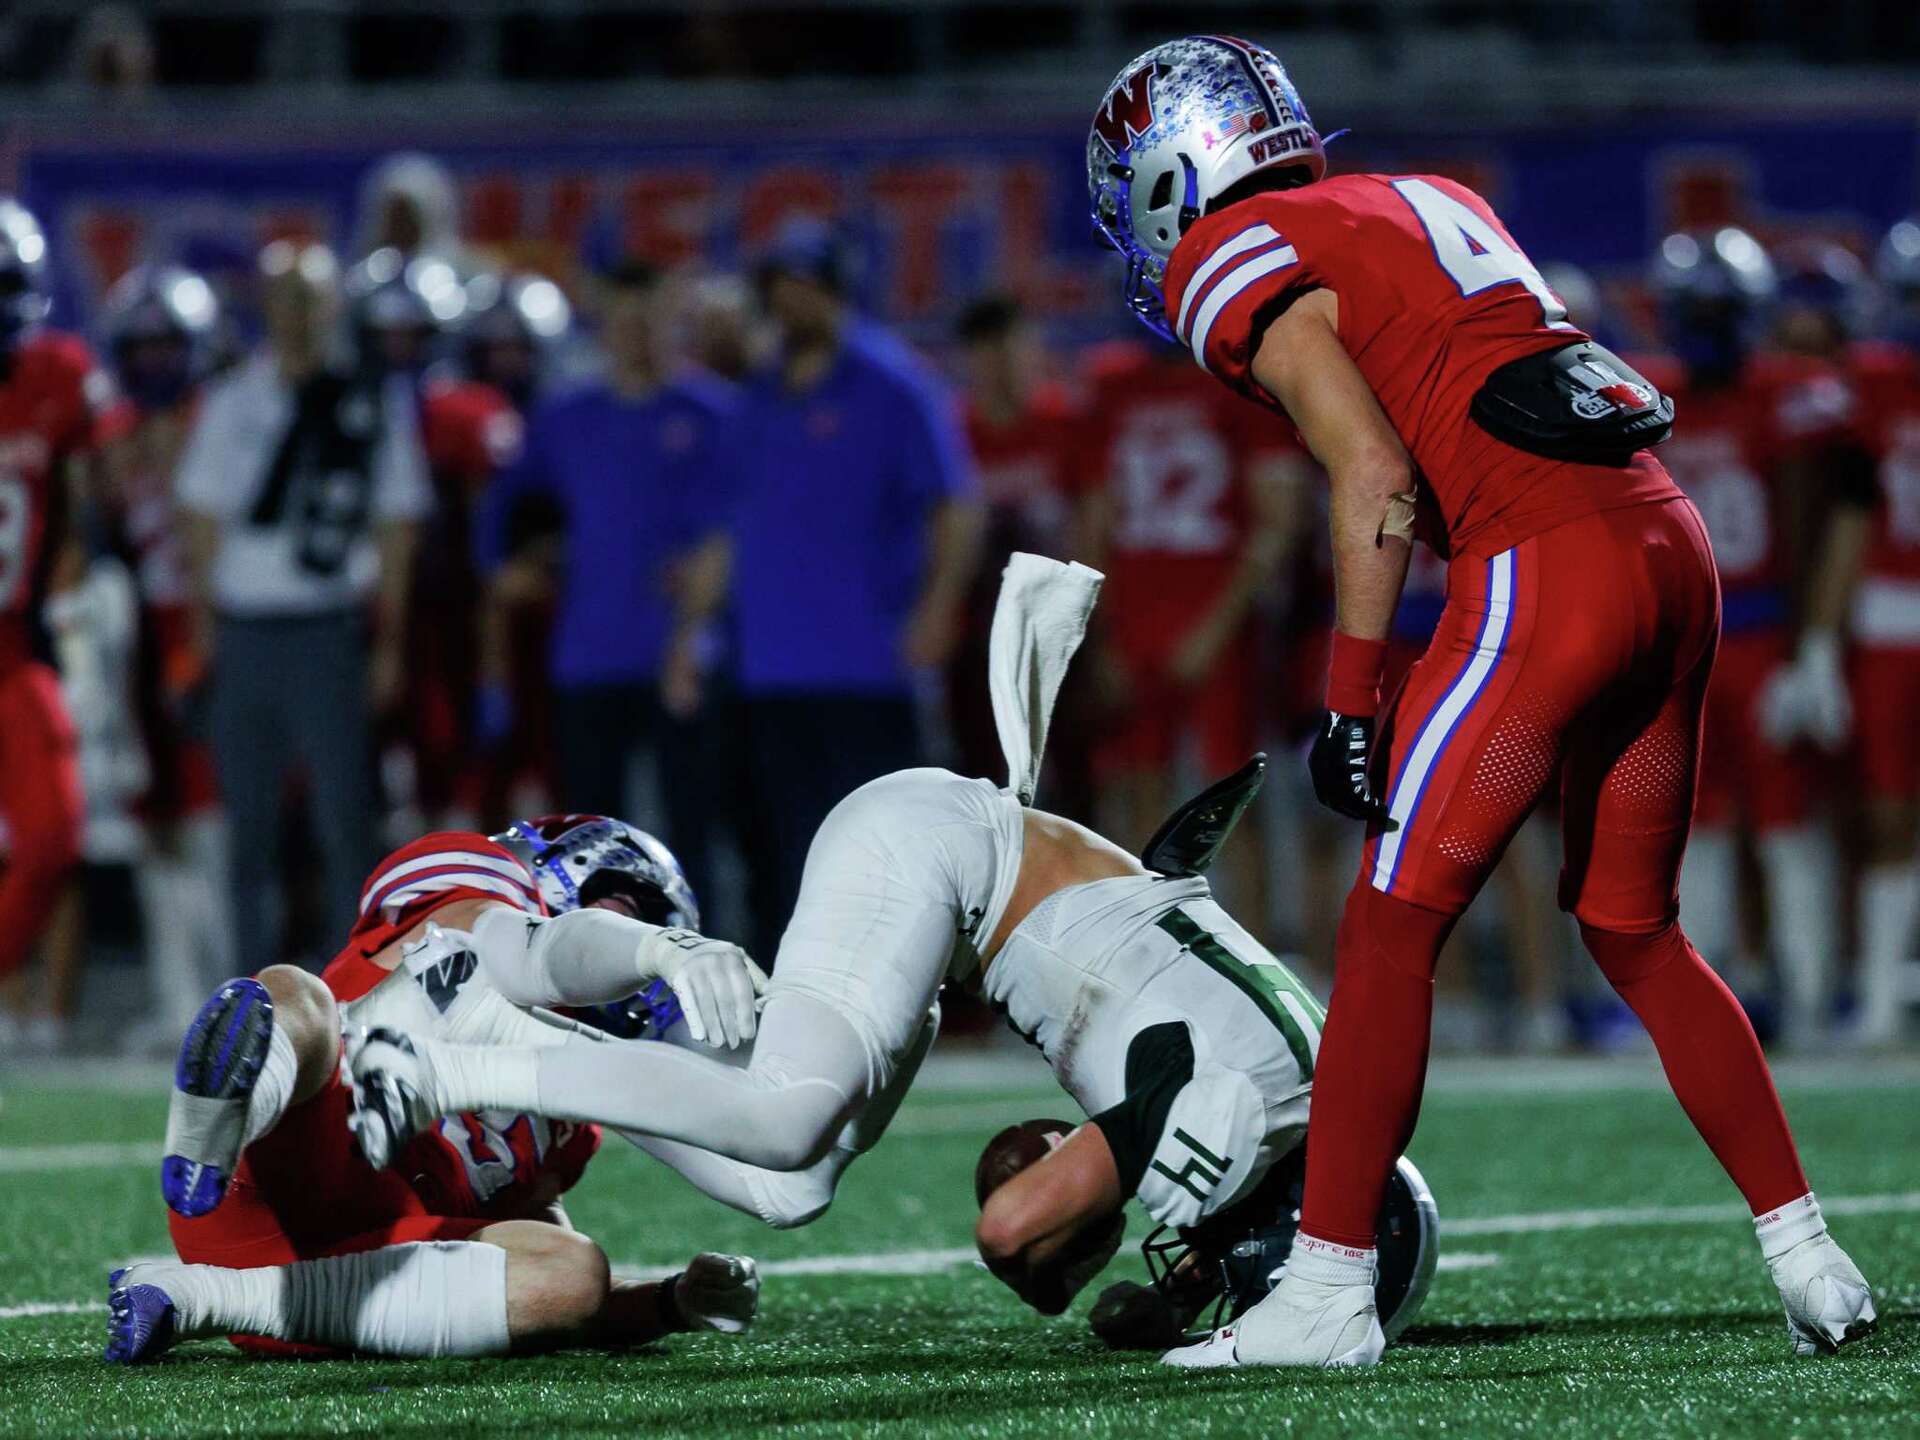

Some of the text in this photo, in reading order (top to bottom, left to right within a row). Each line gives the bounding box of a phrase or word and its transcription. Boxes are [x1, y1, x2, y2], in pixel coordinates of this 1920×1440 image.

[1094, 60, 1157, 158] W
[1391, 177, 1577, 330] 4
[1150, 1126, 1234, 1202] 14
